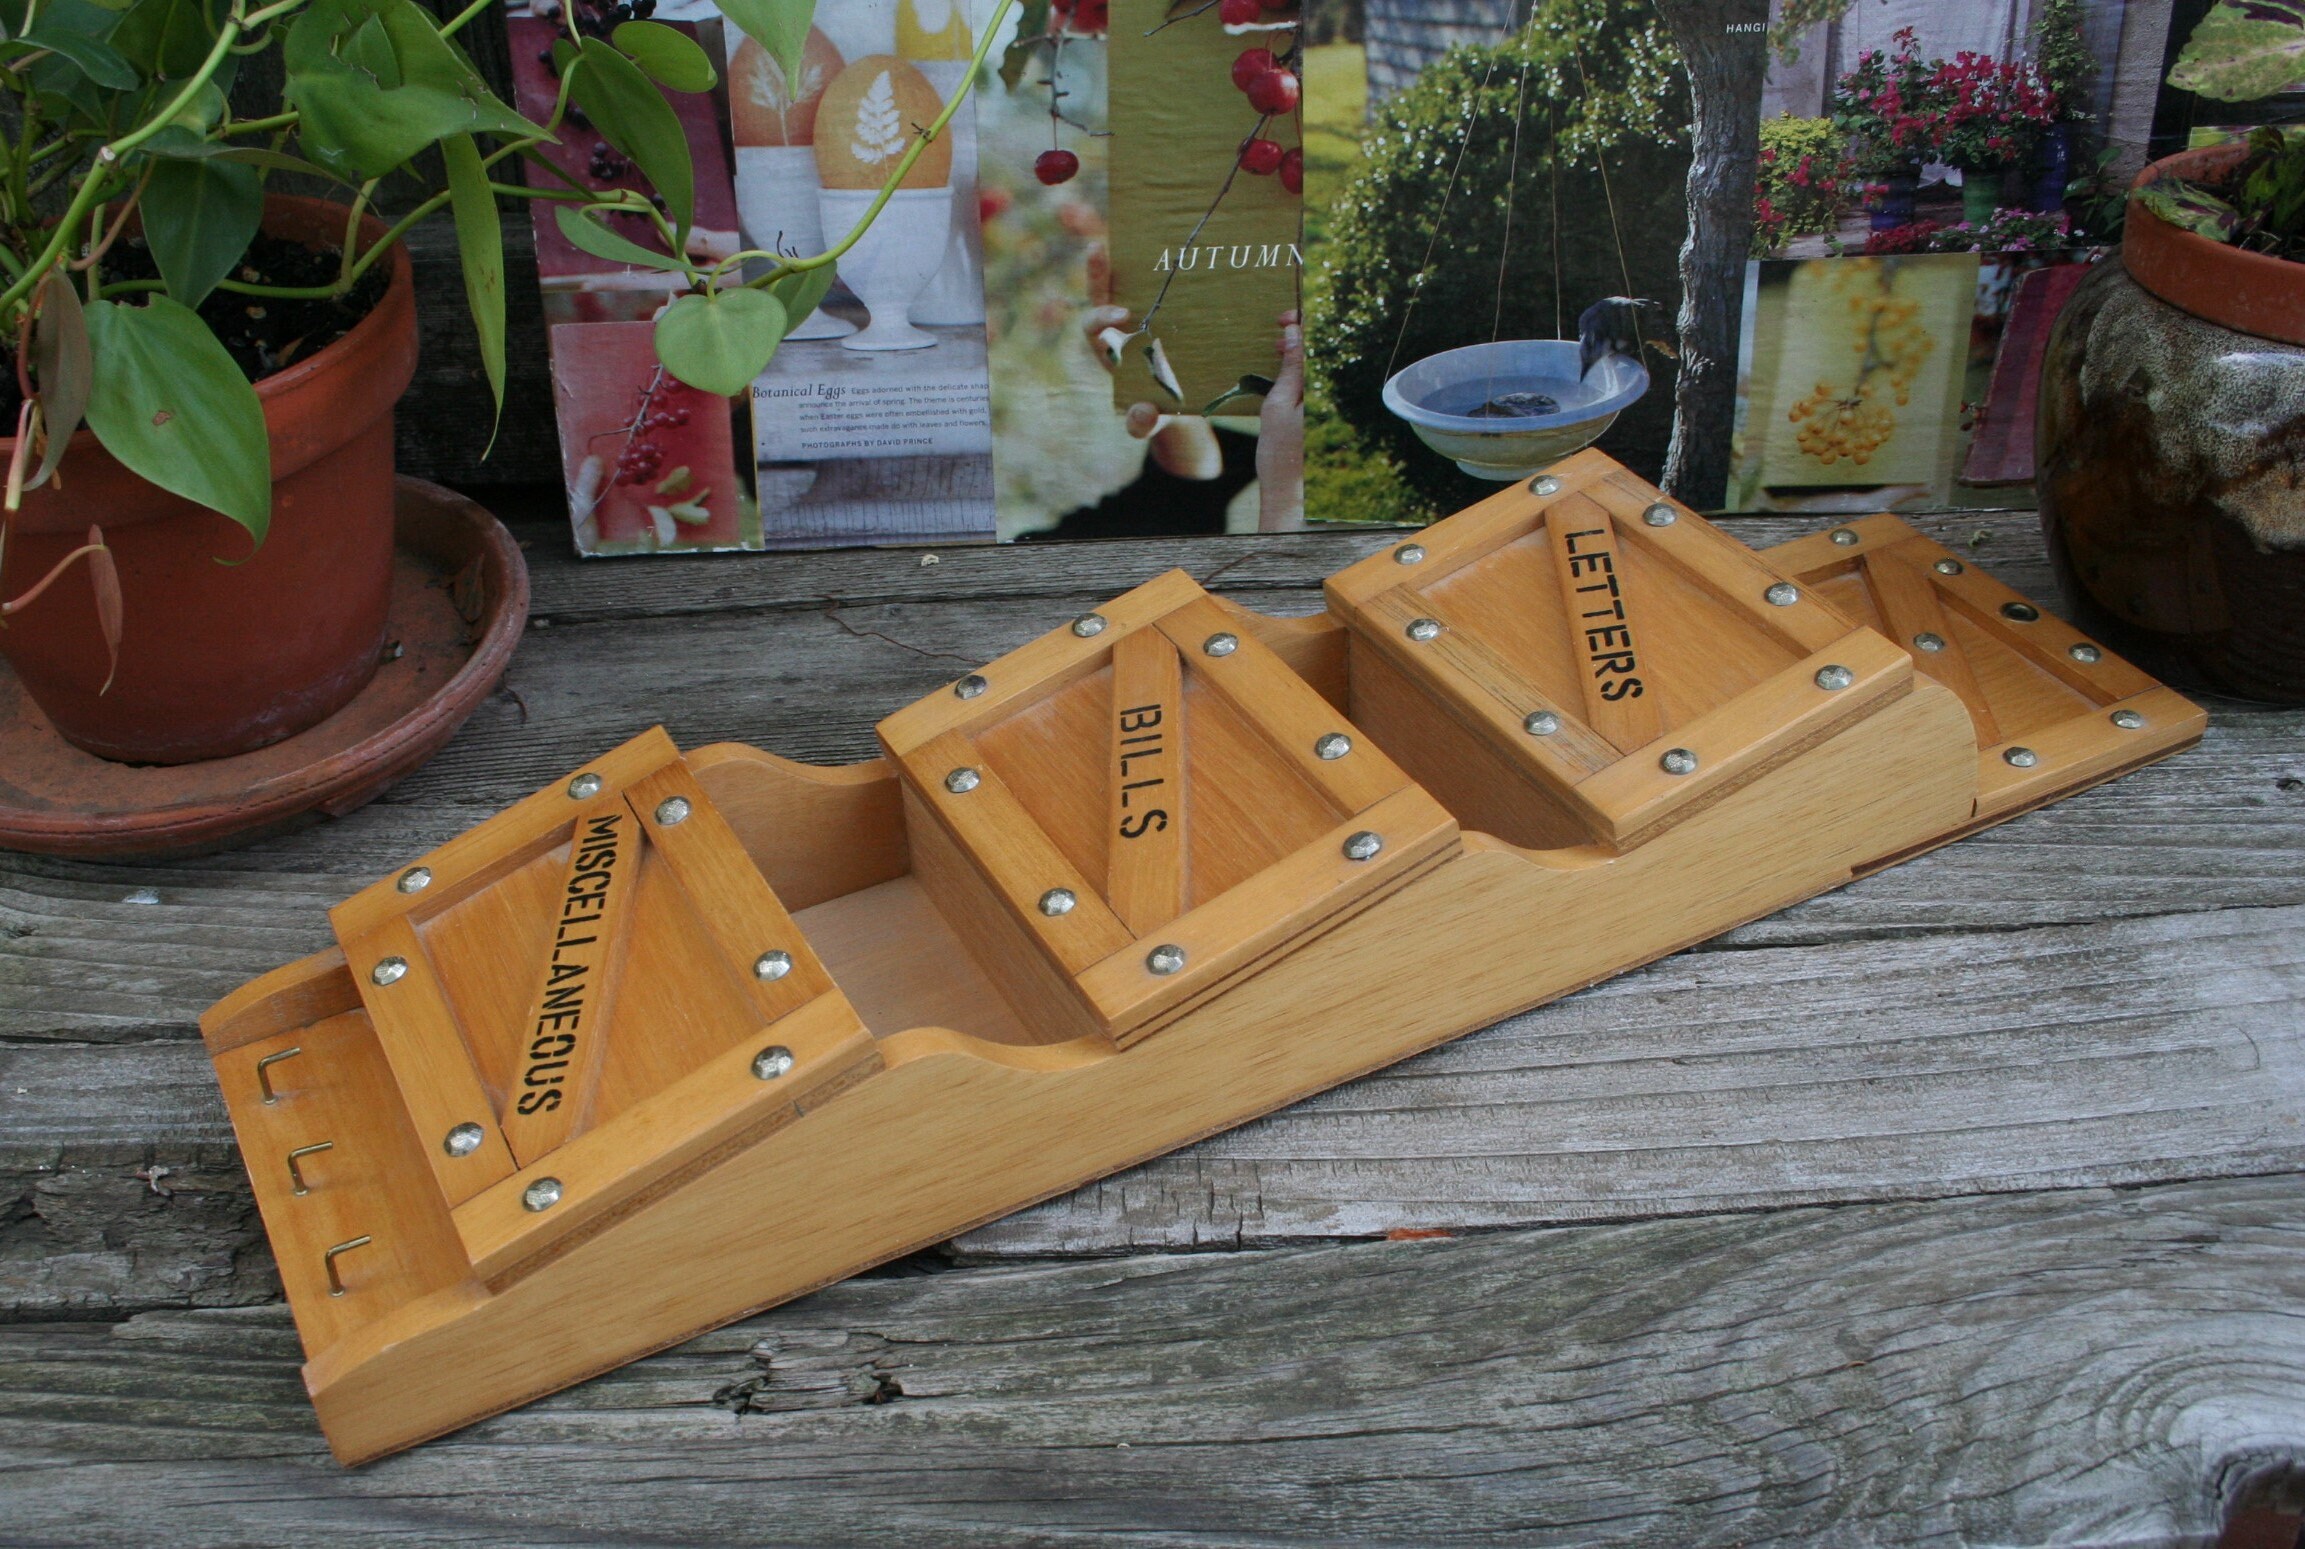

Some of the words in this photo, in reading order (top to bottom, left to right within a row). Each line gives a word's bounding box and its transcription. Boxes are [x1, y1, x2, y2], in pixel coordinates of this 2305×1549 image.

[1153, 243, 1304, 272] AUTUMN
[753, 384, 812, 398] Botanical
[818, 384, 846, 399] Eggs
[872, 386, 903, 394] adorned
[905, 385, 921, 393] with
[939, 383, 968, 391] delicate
[845, 413, 863, 421] eggs
[884, 410, 903, 418] often
[905, 409, 950, 417] embellished
[944, 420, 958, 428] and
[801, 440, 862, 449] PHOTOGRAPHS
[877, 439, 901, 447] DAVID
[903, 437, 934, 446] PRINCE
[1564, 528, 1643, 701] LETTERS
[1119, 703, 1168, 839] BILLS
[516, 814, 623, 1116] MISCELLANEOUS
